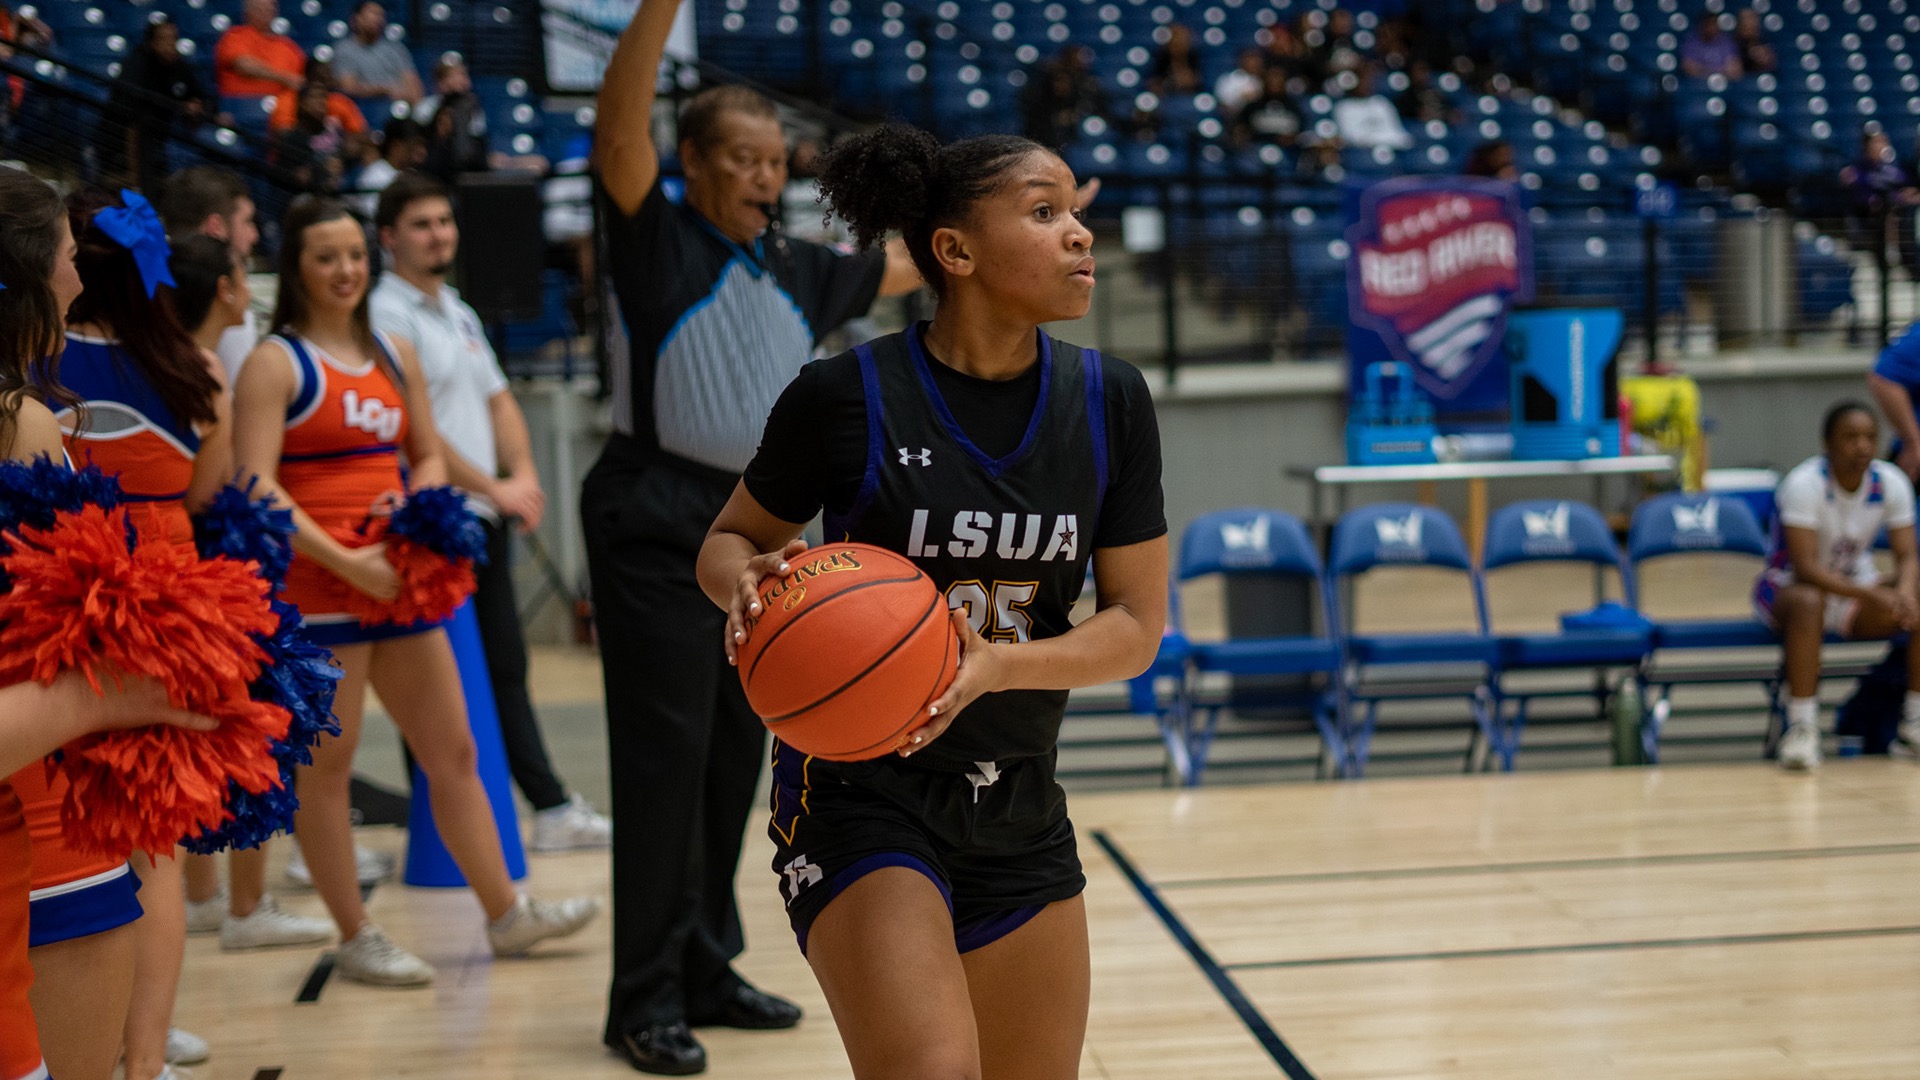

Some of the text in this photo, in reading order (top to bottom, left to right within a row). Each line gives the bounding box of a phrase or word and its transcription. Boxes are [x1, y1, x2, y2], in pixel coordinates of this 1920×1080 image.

[1360, 220, 1518, 297] RED RIVER
[907, 508, 1078, 562] LSUA
